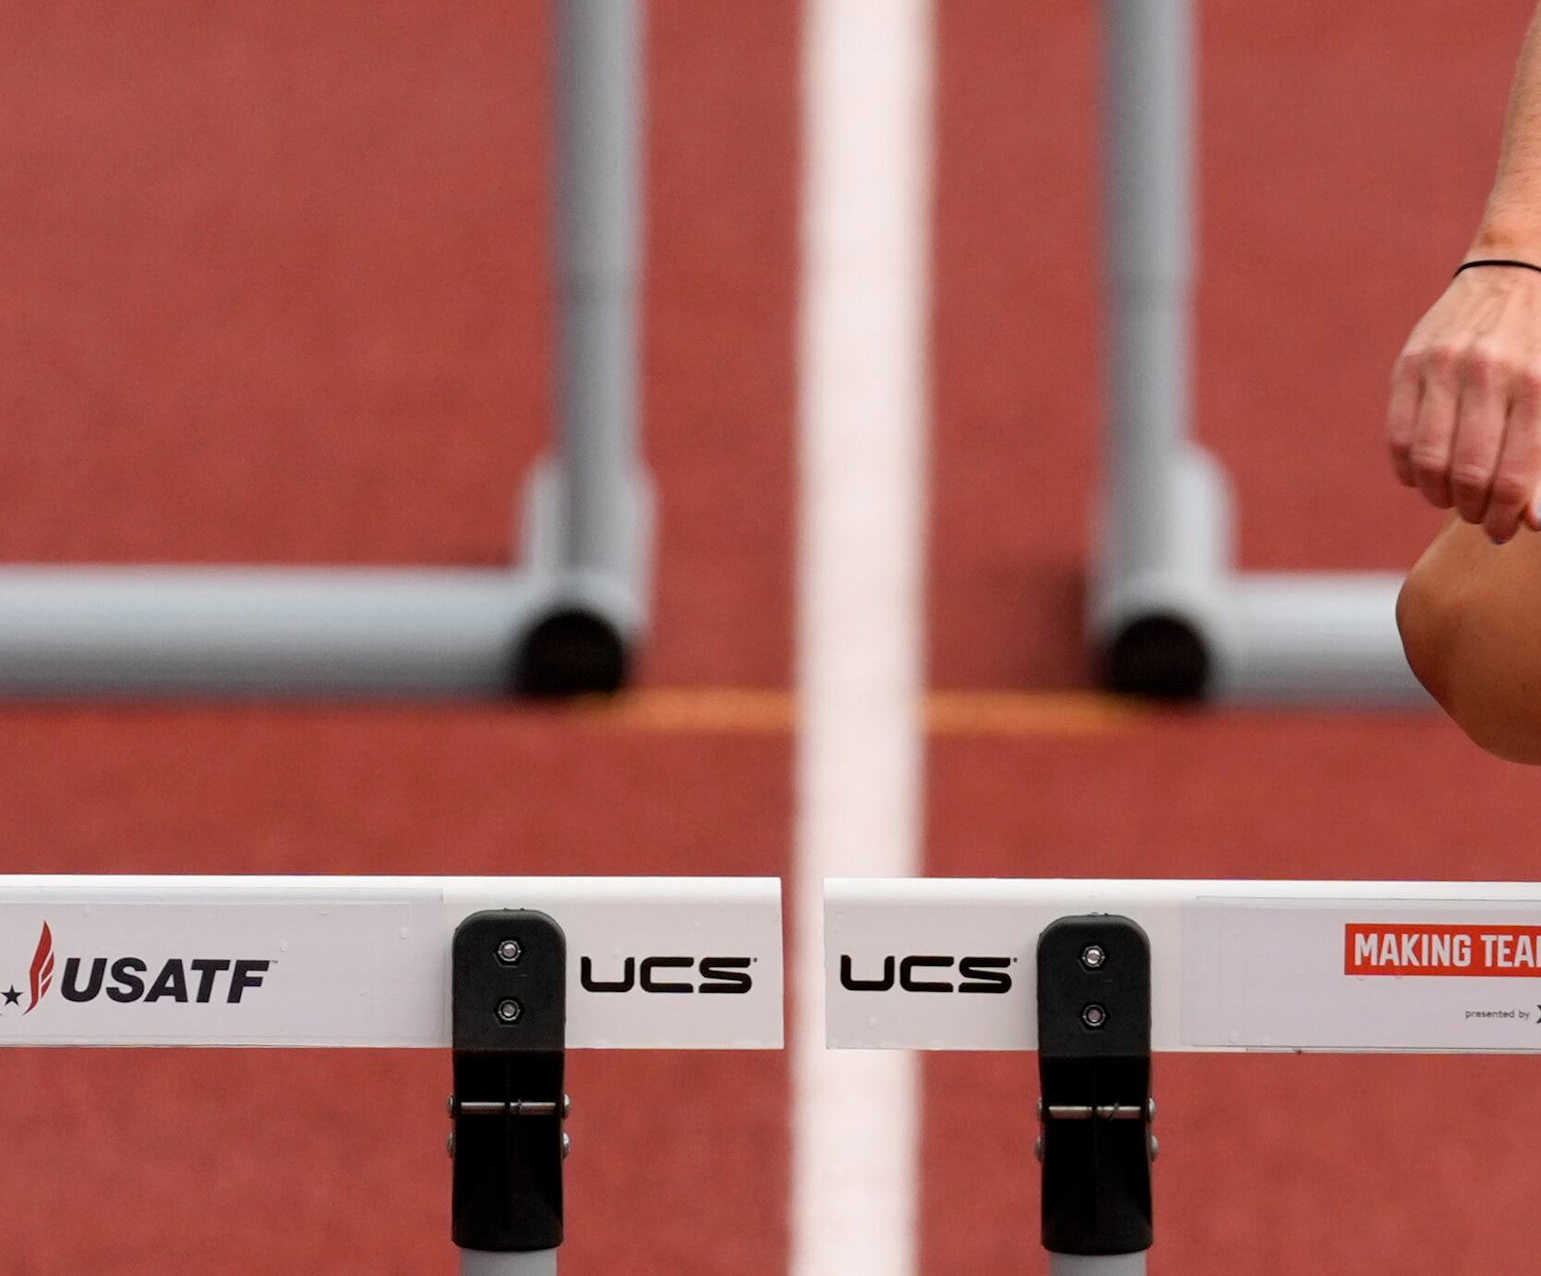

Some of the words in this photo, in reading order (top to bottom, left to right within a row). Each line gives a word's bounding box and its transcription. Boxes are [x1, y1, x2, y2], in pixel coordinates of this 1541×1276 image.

[1354, 933, 1472, 967] MAKING
[60, 956, 271, 1004] USATF
[580, 955, 754, 995] UCS
[839, 954, 1013, 994] UCS
[1465, 1008, 1515, 1020] presented
[1518, 1008, 1530, 1020] by
